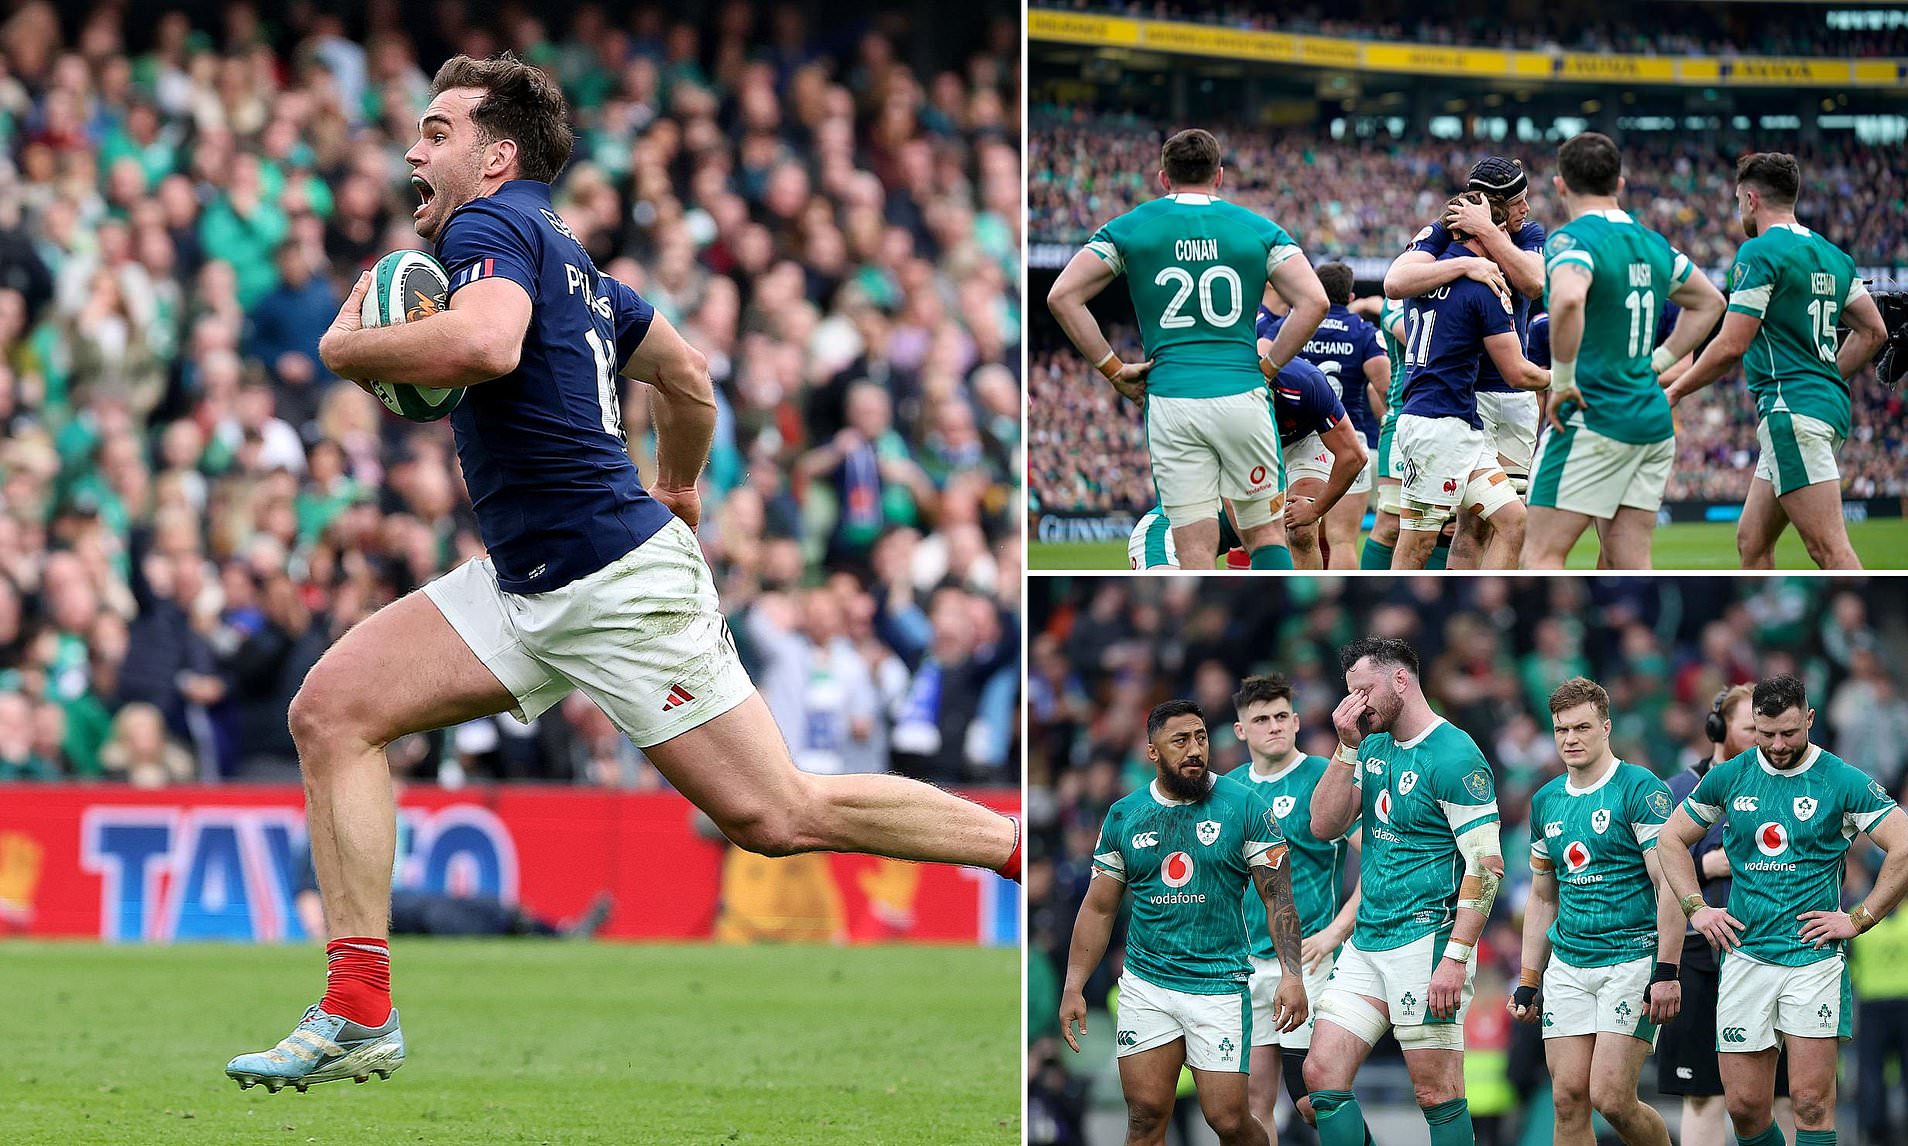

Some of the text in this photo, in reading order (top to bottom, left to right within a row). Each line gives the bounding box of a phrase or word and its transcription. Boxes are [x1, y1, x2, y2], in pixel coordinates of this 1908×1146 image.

[1175, 239, 1219, 261] CONAN
[1154, 265, 1243, 329] 20
[1811, 272, 1836, 296] KEENAN
[1404, 311, 1437, 367] 21
[1625, 290, 1655, 358] 11
[1807, 299, 1839, 363] 15
[1302, 340, 1354, 356] RCHAND
[80, 804, 520, 943] TAYO
[1744, 860, 1797, 872] vodafone
[1150, 891, 1206, 905] vodafone
